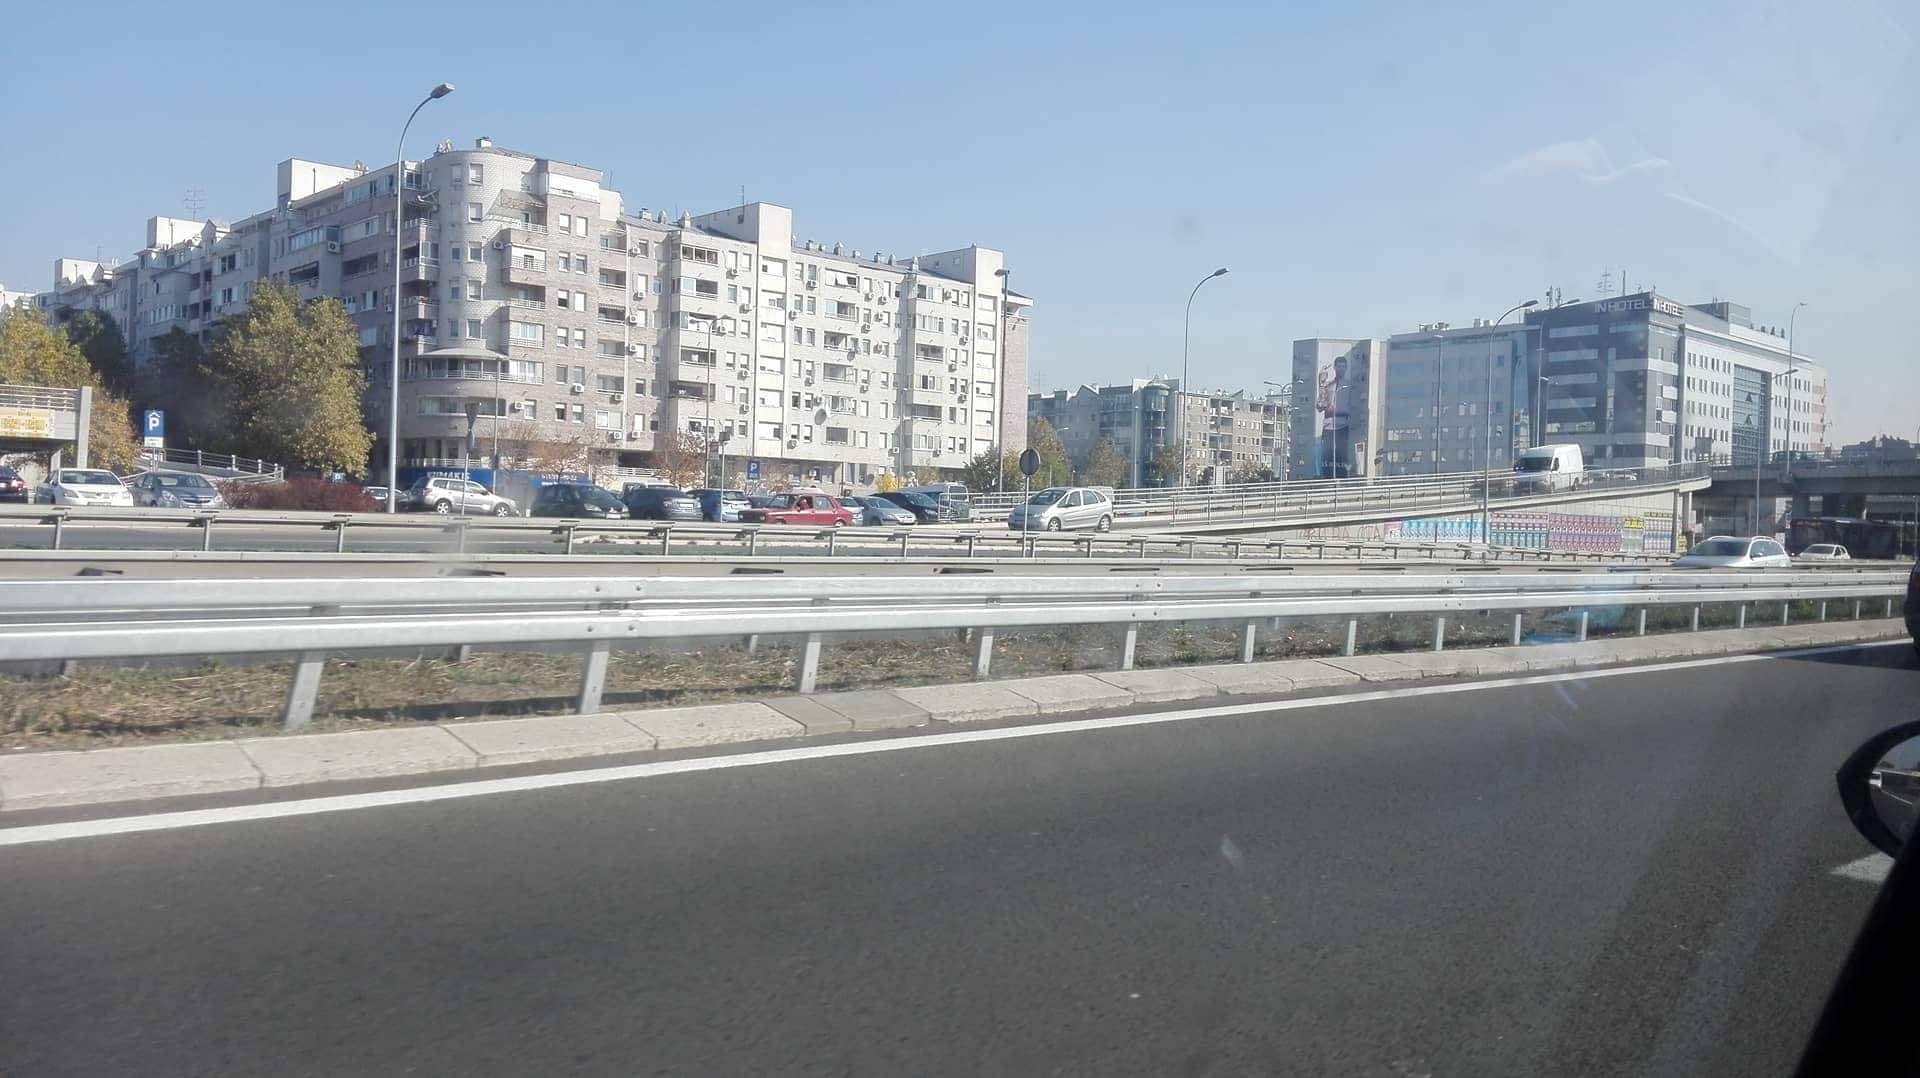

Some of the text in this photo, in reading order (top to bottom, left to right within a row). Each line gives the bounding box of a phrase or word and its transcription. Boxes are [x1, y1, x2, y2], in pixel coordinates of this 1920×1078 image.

[1594, 299, 1649, 313] IN HOTEL
[149, 417, 160, 431] P
